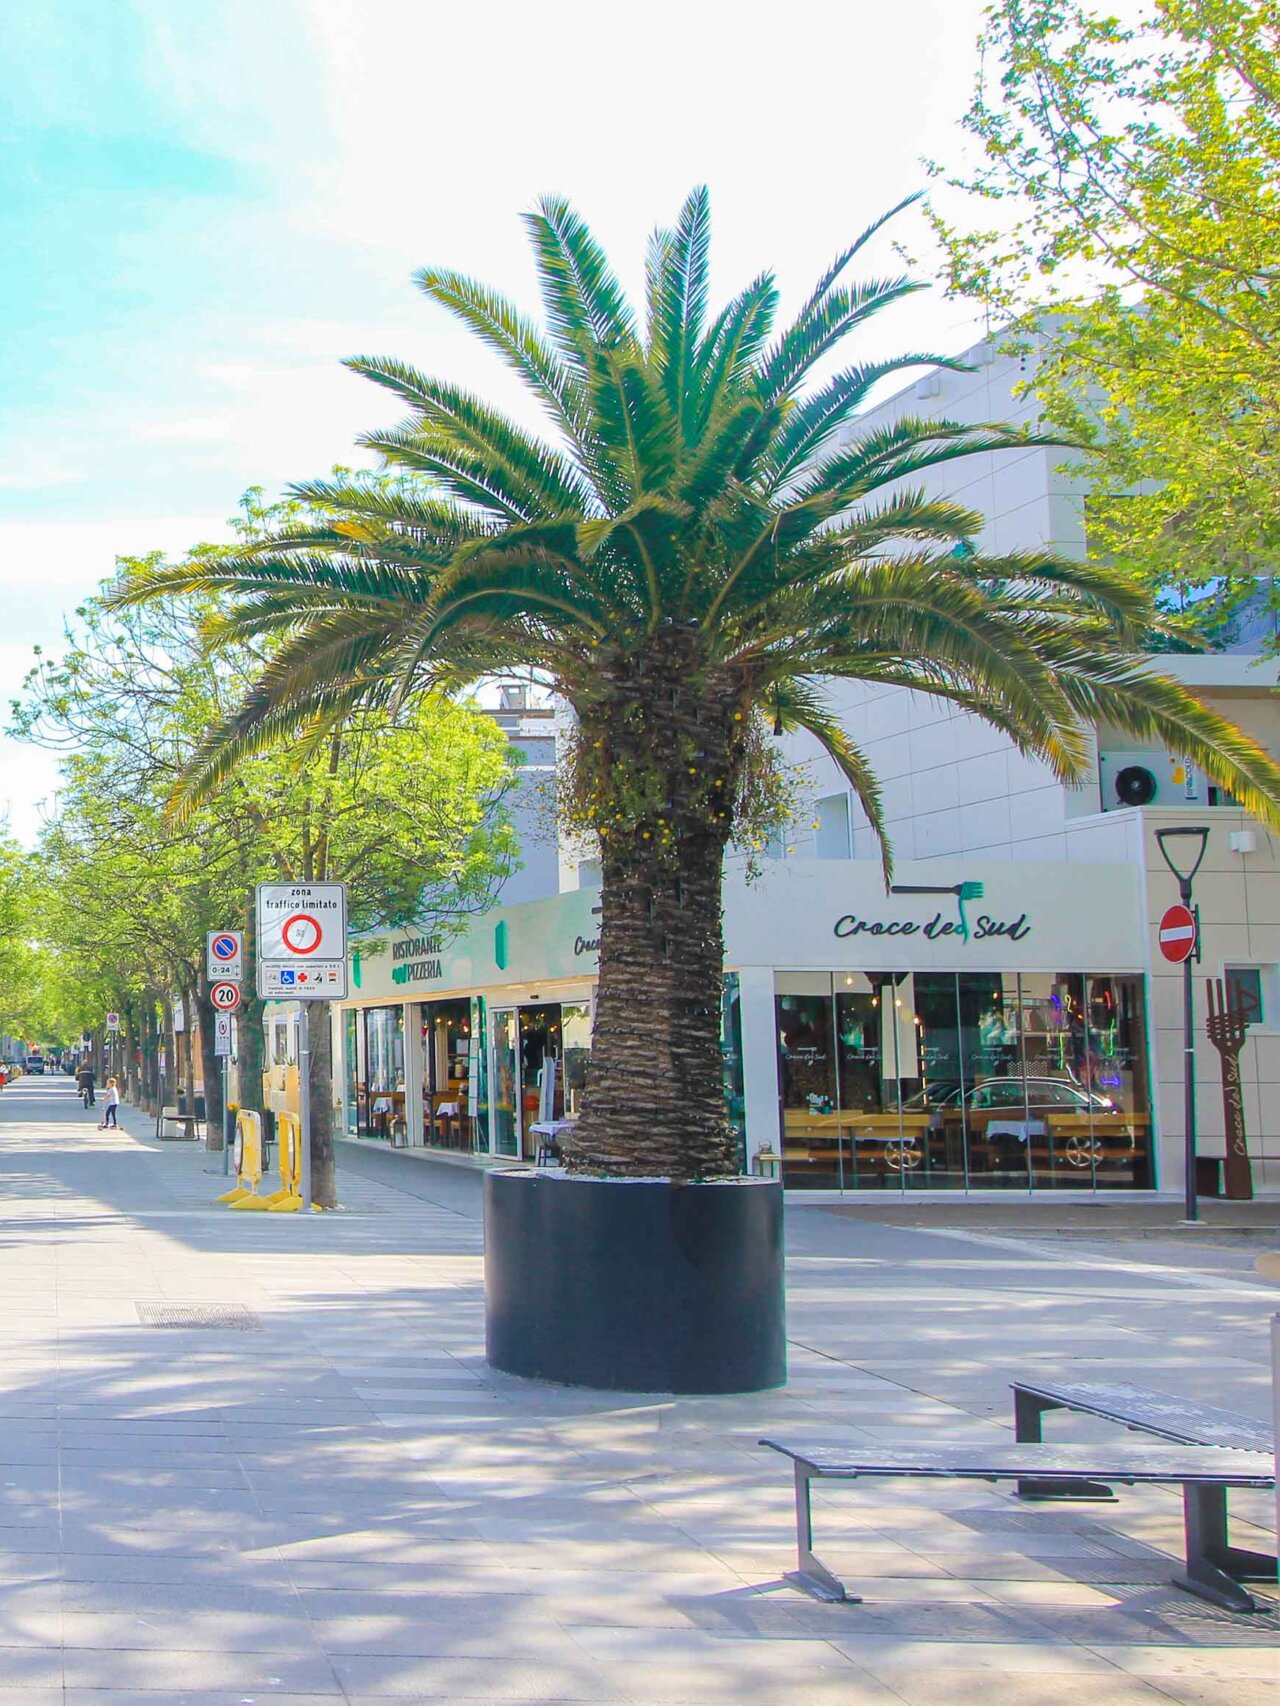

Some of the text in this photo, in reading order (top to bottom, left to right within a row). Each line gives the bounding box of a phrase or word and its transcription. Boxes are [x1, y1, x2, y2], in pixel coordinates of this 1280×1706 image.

[291, 888, 312, 896] zona
[266, 900, 337, 909] traffico limitato
[833, 914, 921, 939] Croce
[973, 913, 1031, 941] Sud
[392, 934, 443, 961] RISTORANTE
[212, 966, 230, 974] 0-24
[407, 959, 443, 982] PIZZERIA
[218, 989, 234, 1003] 20
[1224, 1053, 1238, 1081] Sud
[1233, 1111, 1246, 1155] Croce
